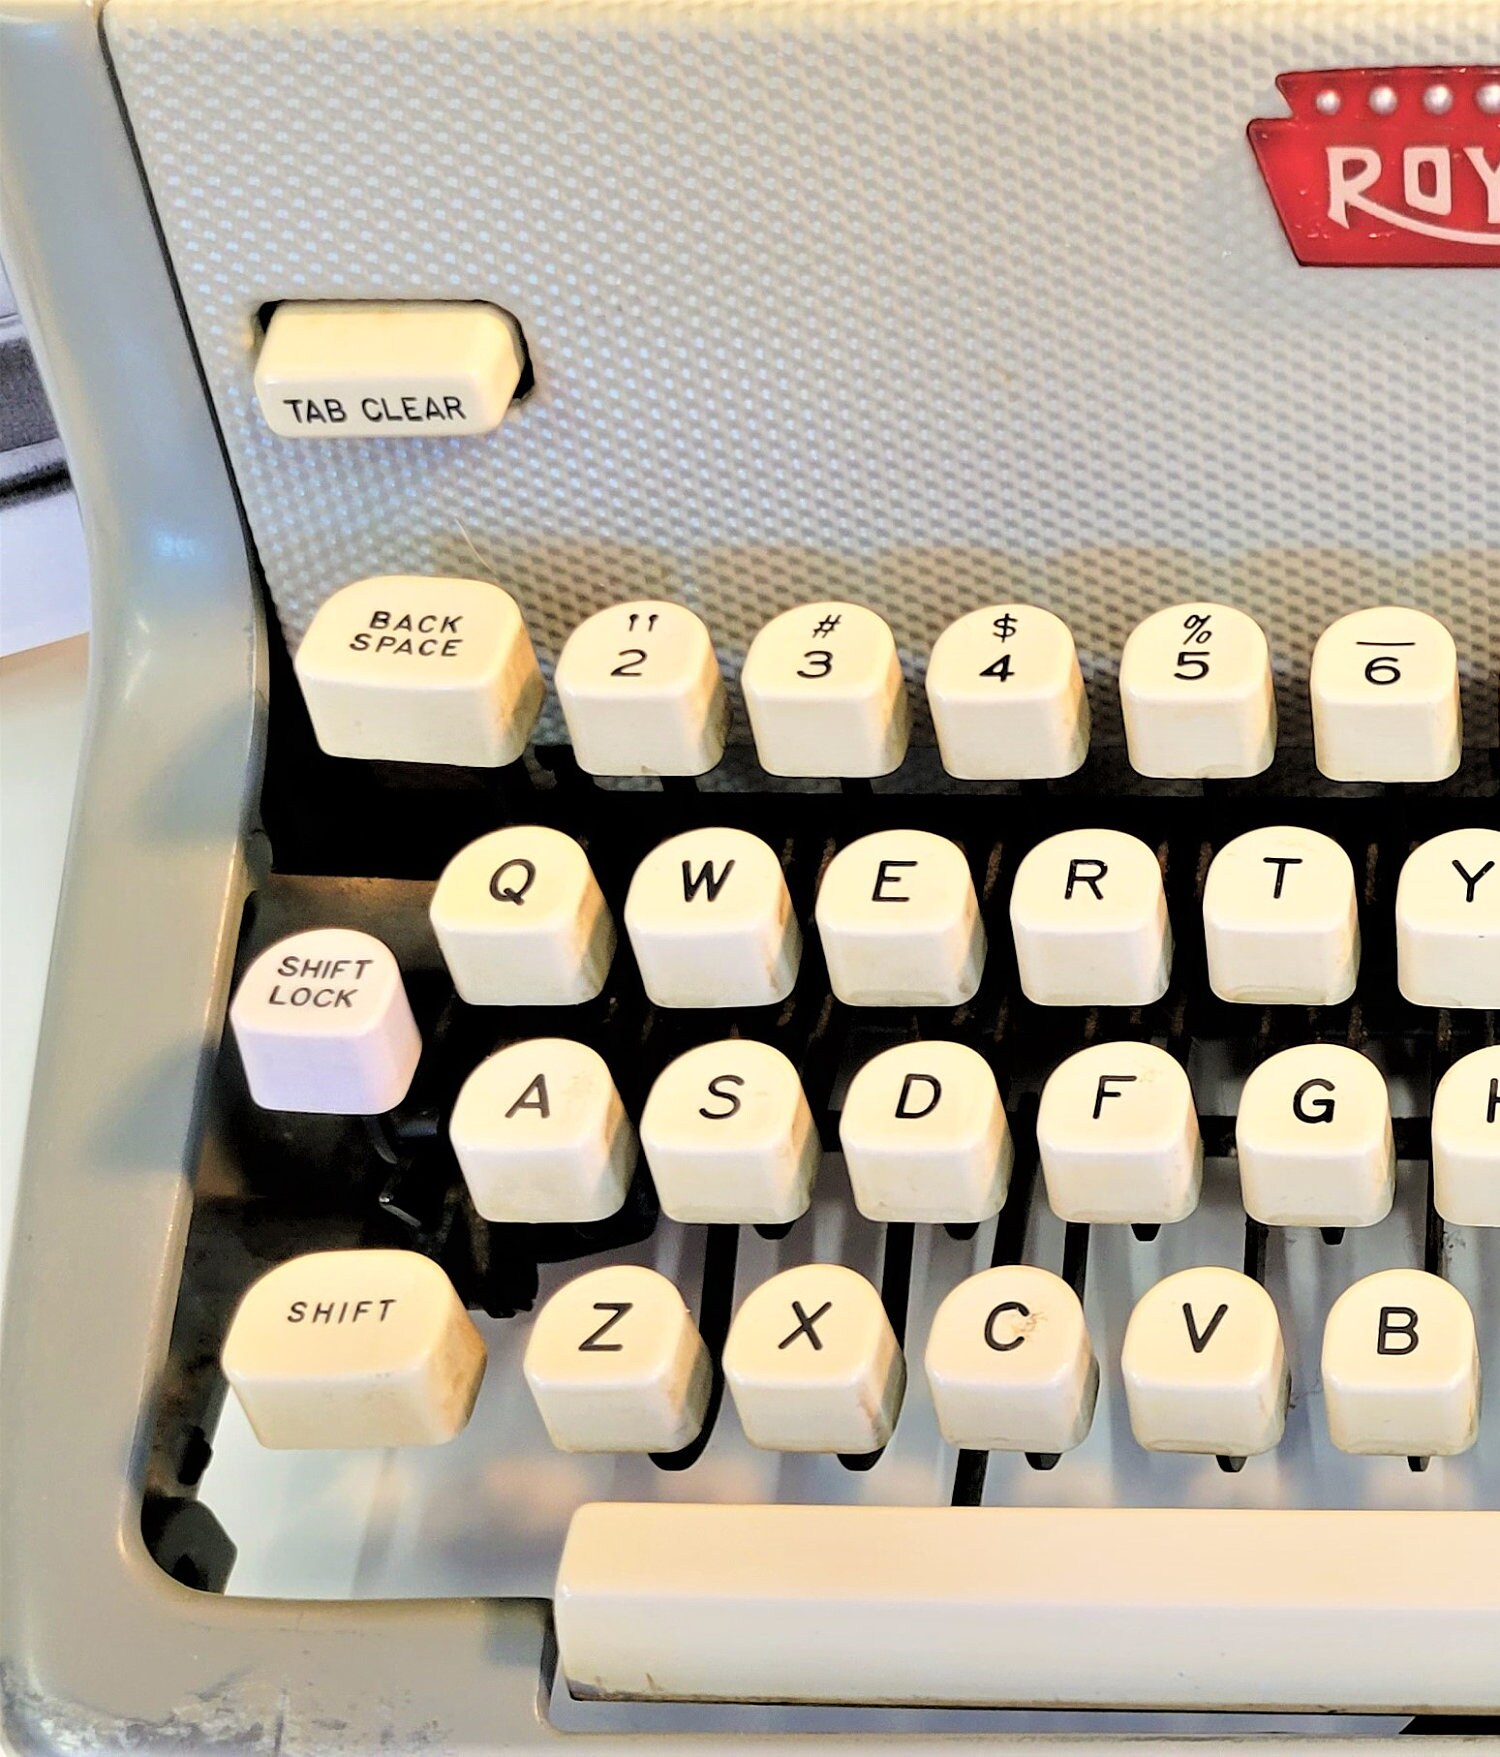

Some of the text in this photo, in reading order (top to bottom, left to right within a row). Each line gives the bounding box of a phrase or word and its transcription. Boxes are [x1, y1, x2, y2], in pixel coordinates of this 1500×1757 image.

[283, 396, 466, 423] TAB CLEAR
[369, 610, 463, 635] BACK
[813, 614, 841, 639] #
[993, 612, 1018, 643] $
[1183, 614, 1213, 645] %
[348, 633, 464, 658] SPACE
[610, 648, 647, 677] 2
[796, 650, 833, 679] 3
[1173, 651, 1211, 681] 5
[979, 653, 1015, 683] 4
[1364, 656, 1401, 686] 6
[489, 858, 536, 906] Q
[681, 859, 736, 903] W
[871, 860, 918, 903] E
[1064, 858, 1109, 901] R
[1262, 856, 1303, 900] T
[1451, 859, 1496, 903] Y
[277, 955, 373, 980] SHIFT
[268, 985, 358, 1008] LOCK
[504, 1073, 550, 1119] A
[698, 1074, 745, 1120] S
[894, 1073, 942, 1120] D
[1092, 1074, 1138, 1120] F
[1292, 1078, 1336, 1125] G
[287, 1299, 396, 1324] SHIFT
[578, 1302, 633, 1352] Z
[777, 1300, 832, 1351] X
[983, 1301, 1030, 1352] C
[1182, 1302, 1229, 1354] V
[1376, 1306, 1419, 1356] B
